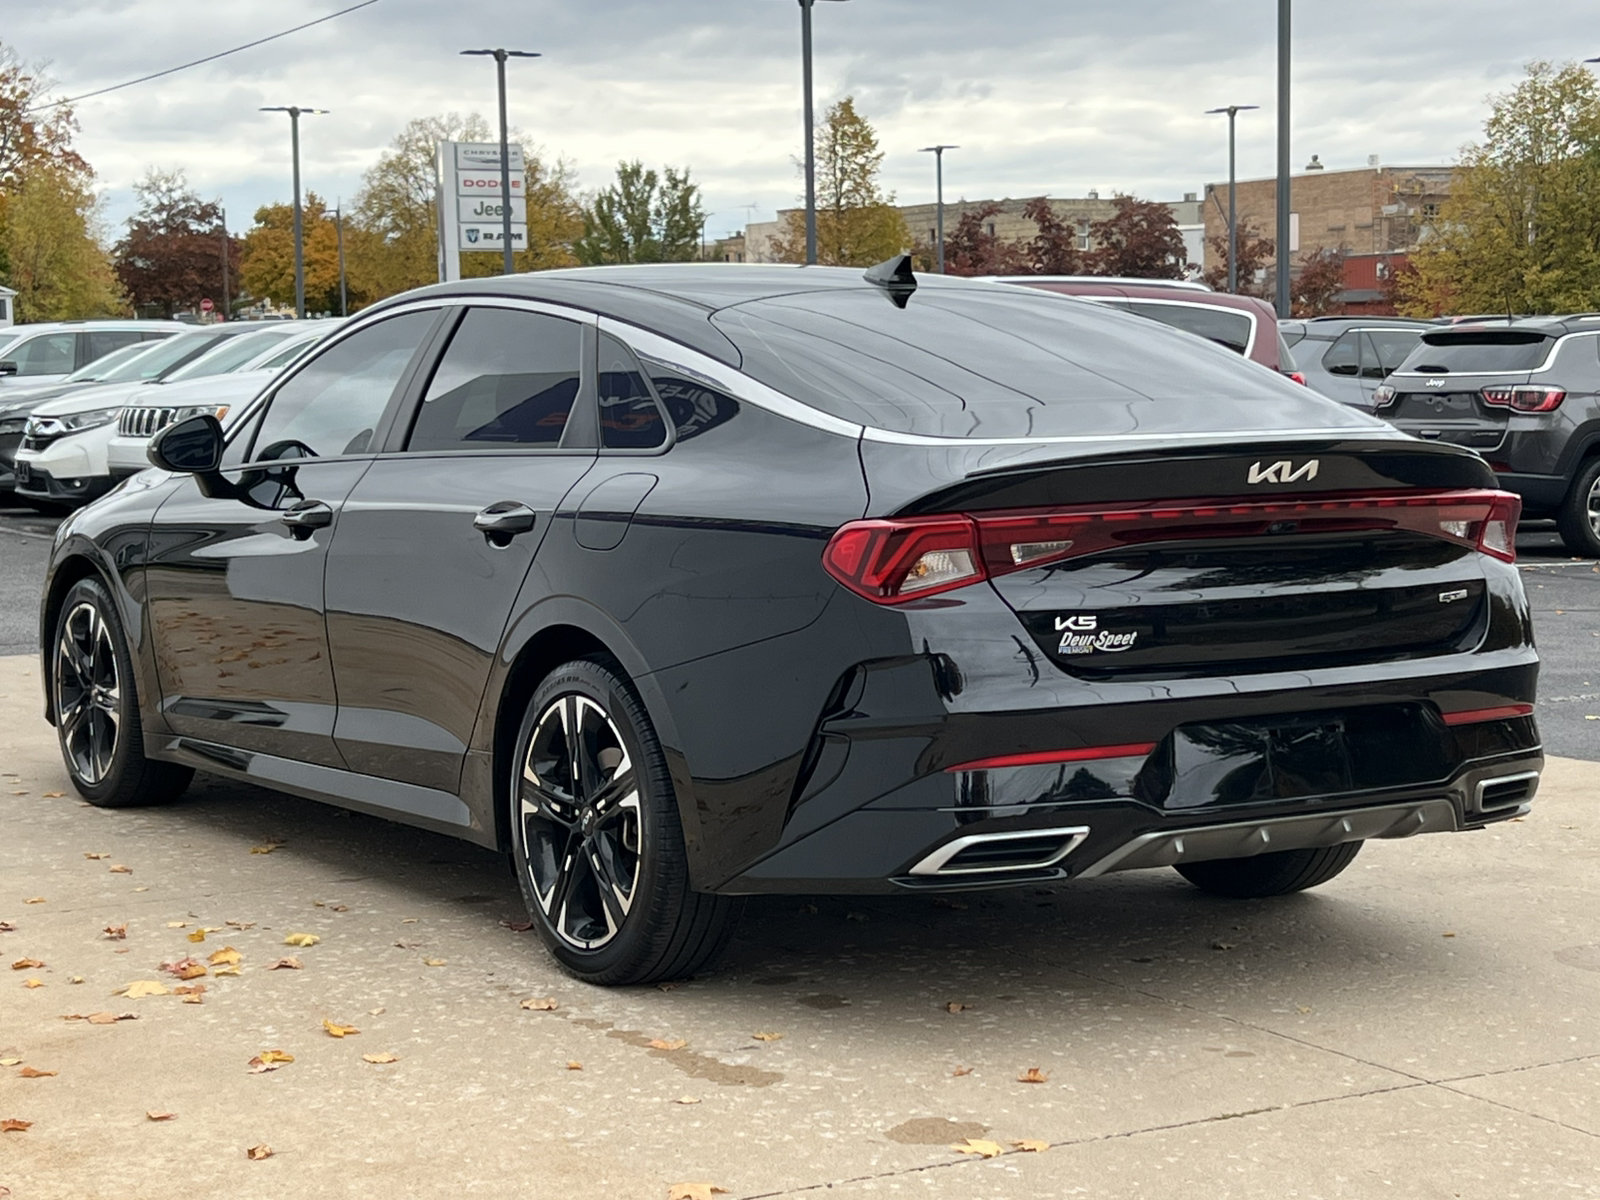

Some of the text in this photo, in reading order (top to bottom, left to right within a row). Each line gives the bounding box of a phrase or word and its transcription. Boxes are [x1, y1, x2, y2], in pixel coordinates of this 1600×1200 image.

[463, 179, 521, 188] DODE
[473, 201, 513, 216] Jee
[1247, 459, 1320, 484] KIA
[1054, 615, 1097, 630] K5
[1059, 631, 1096, 646] Deur
